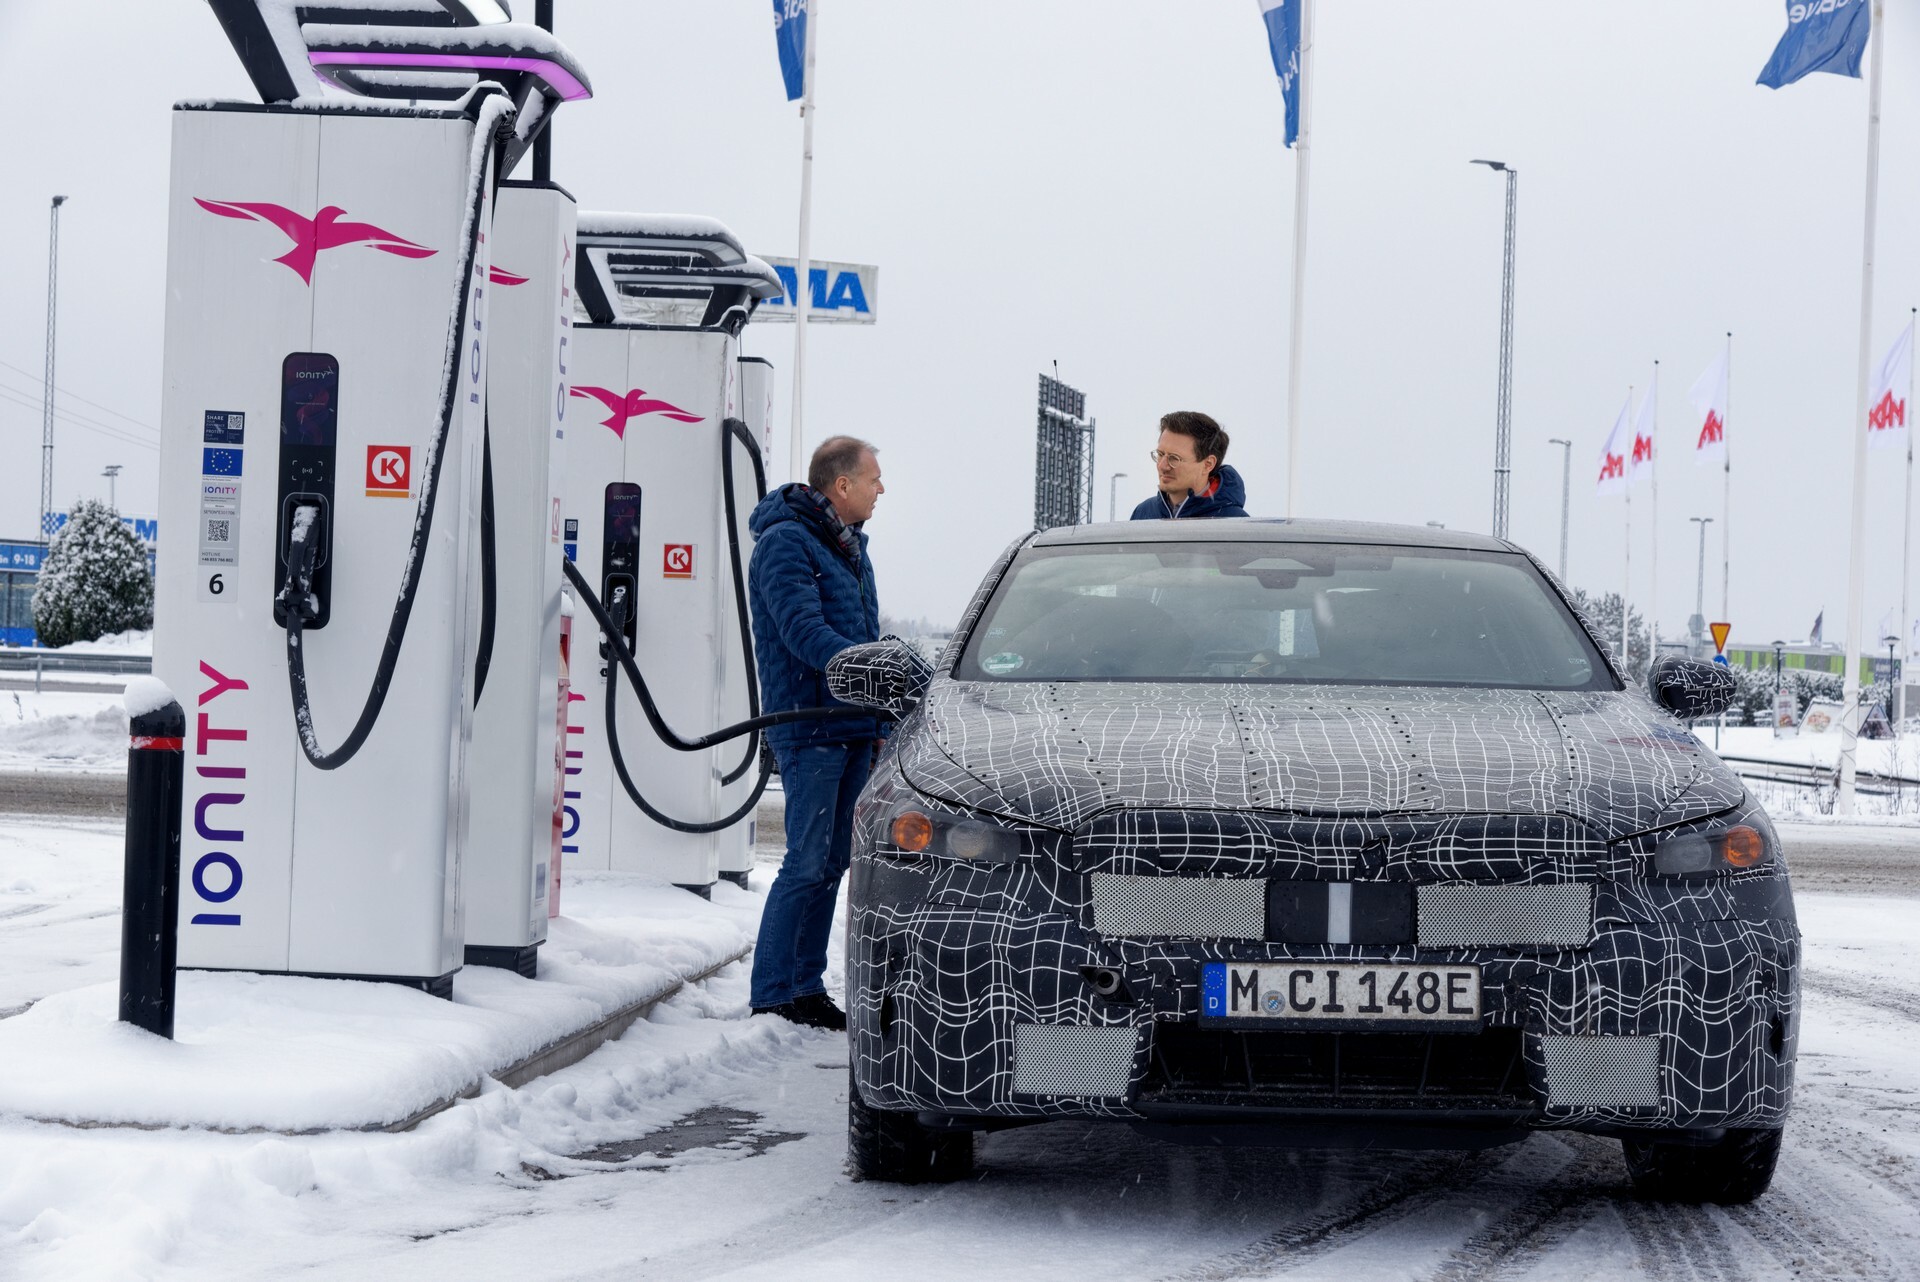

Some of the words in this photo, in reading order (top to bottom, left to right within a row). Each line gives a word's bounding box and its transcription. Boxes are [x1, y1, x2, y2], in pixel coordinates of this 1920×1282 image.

[556, 233, 571, 440] IONITY
[296, 371, 326, 379] IONITY
[204, 486, 237, 494] IONITY
[13, 553, 35, 566] 9-18
[209, 573, 224, 595] 6
[190, 659, 249, 926] IONITY
[1209, 997, 1219, 1009] D
[1231, 969, 1259, 1012] M
[1289, 969, 1345, 1013] CI
[1357, 970, 1474, 1015] 148E
